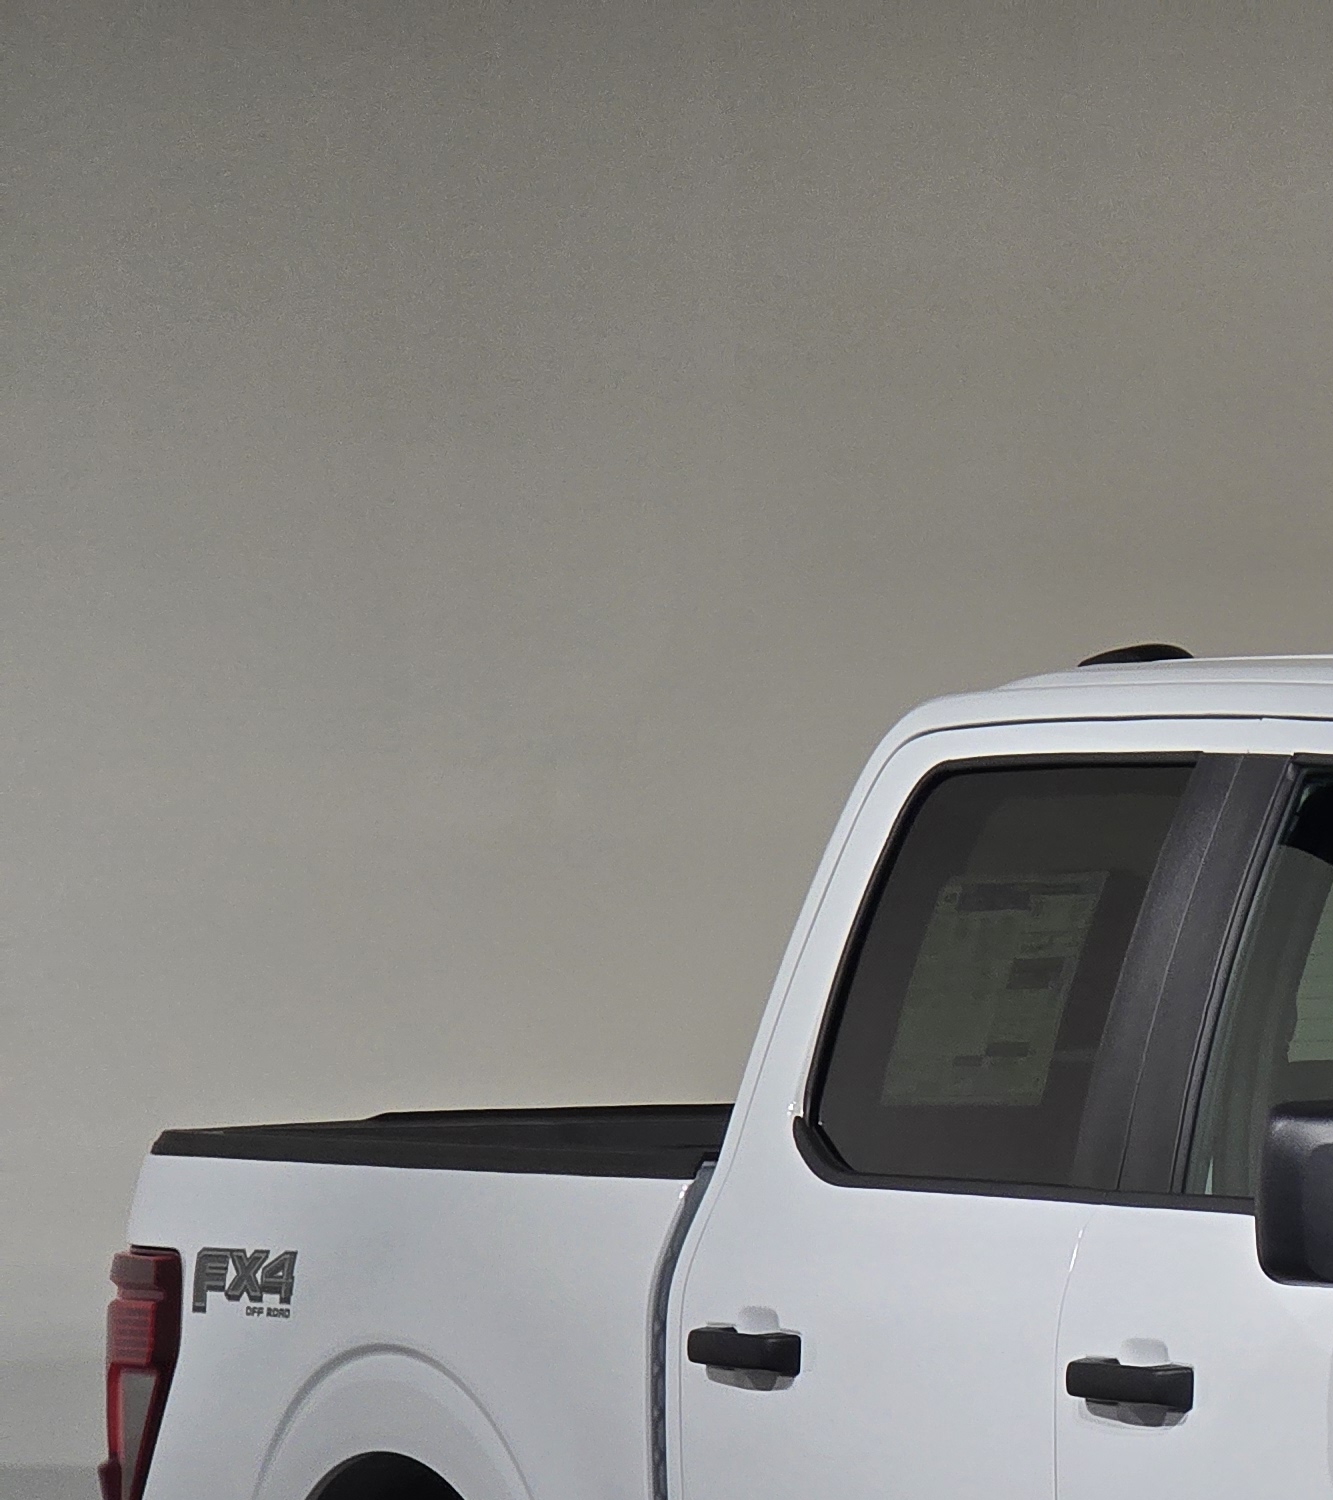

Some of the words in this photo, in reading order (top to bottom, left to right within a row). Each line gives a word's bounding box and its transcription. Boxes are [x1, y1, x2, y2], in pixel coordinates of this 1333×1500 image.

[192, 1247, 298, 1313] FX4
[246, 1306, 264, 1317] OFF
[266, 1307, 291, 1319] ROAD
